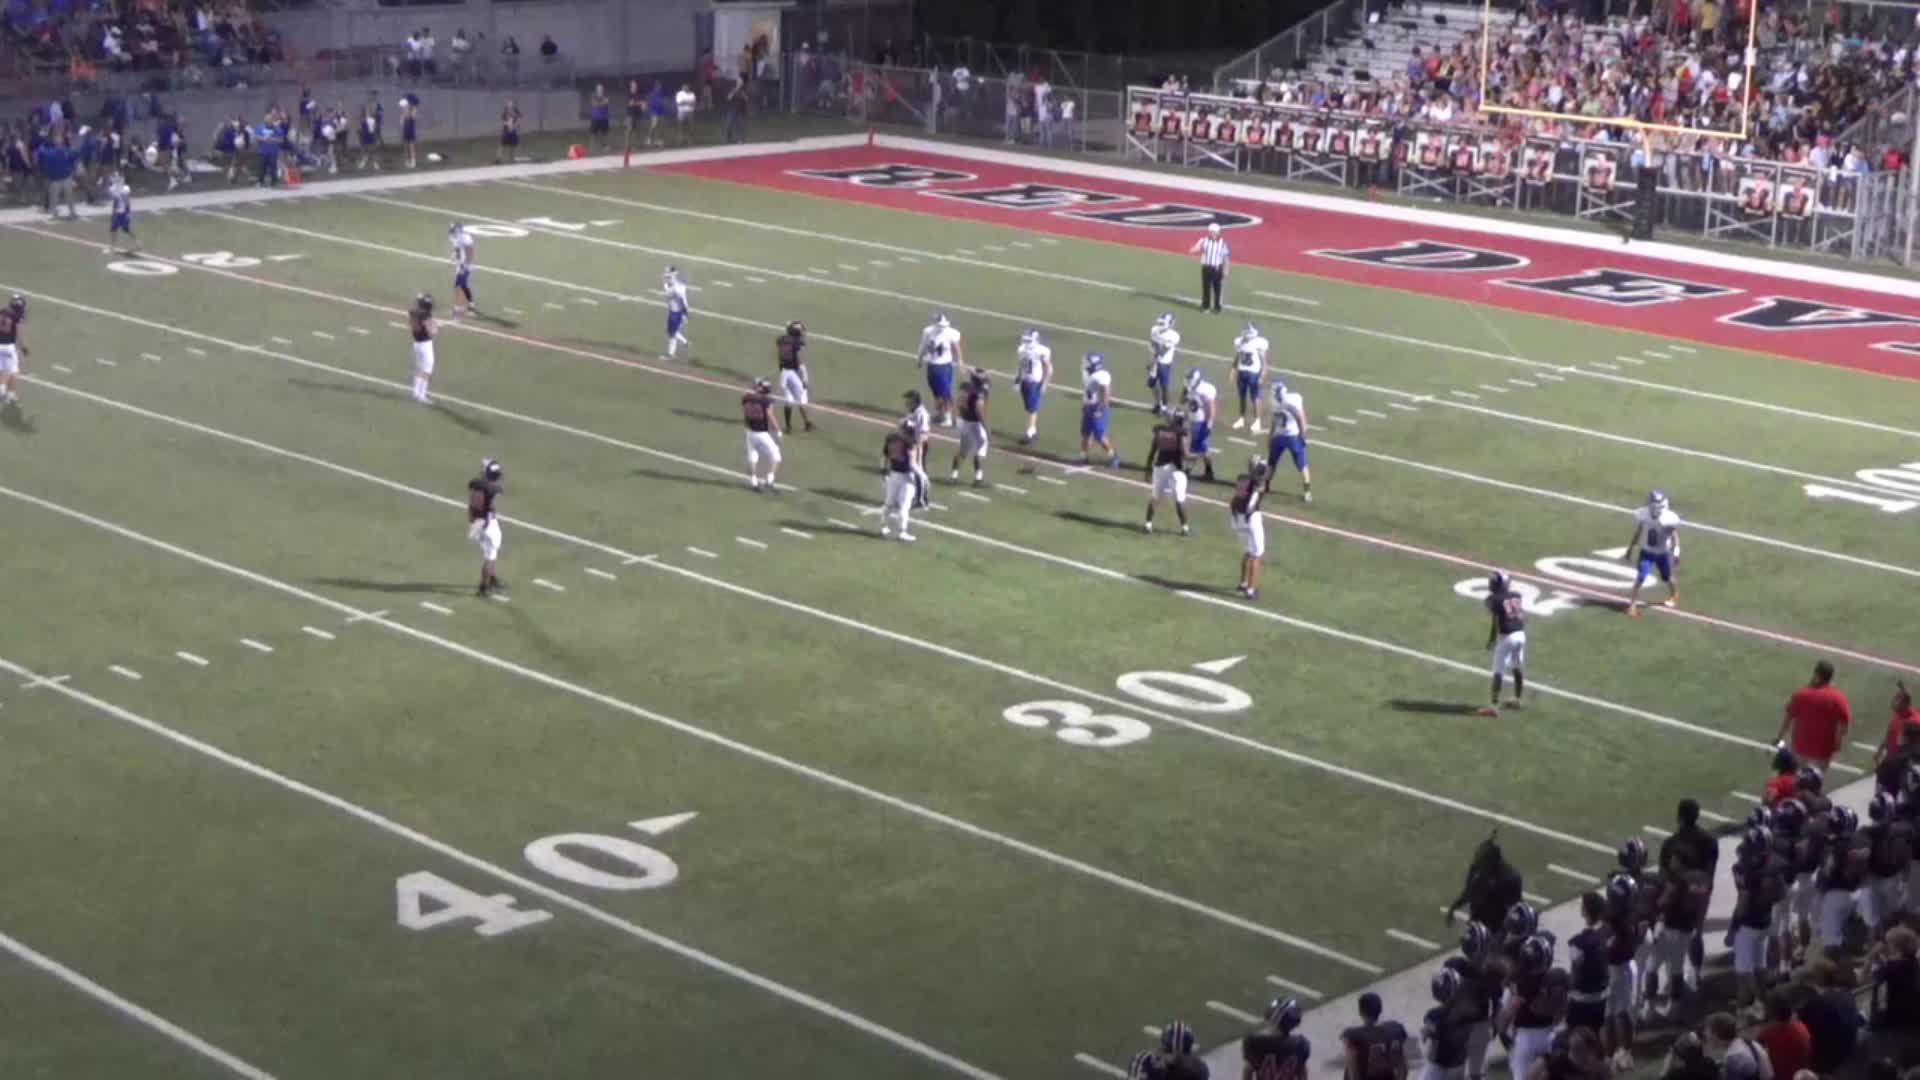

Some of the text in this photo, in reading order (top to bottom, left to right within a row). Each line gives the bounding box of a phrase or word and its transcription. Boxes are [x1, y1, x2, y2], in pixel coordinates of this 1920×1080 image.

[784, 163, 1263, 229] RED
[106, 251, 262, 275] 20
[1453, 556, 1658, 616] 20
[1002, 670, 1253, 747] 30
[395, 832, 679, 937] 40
